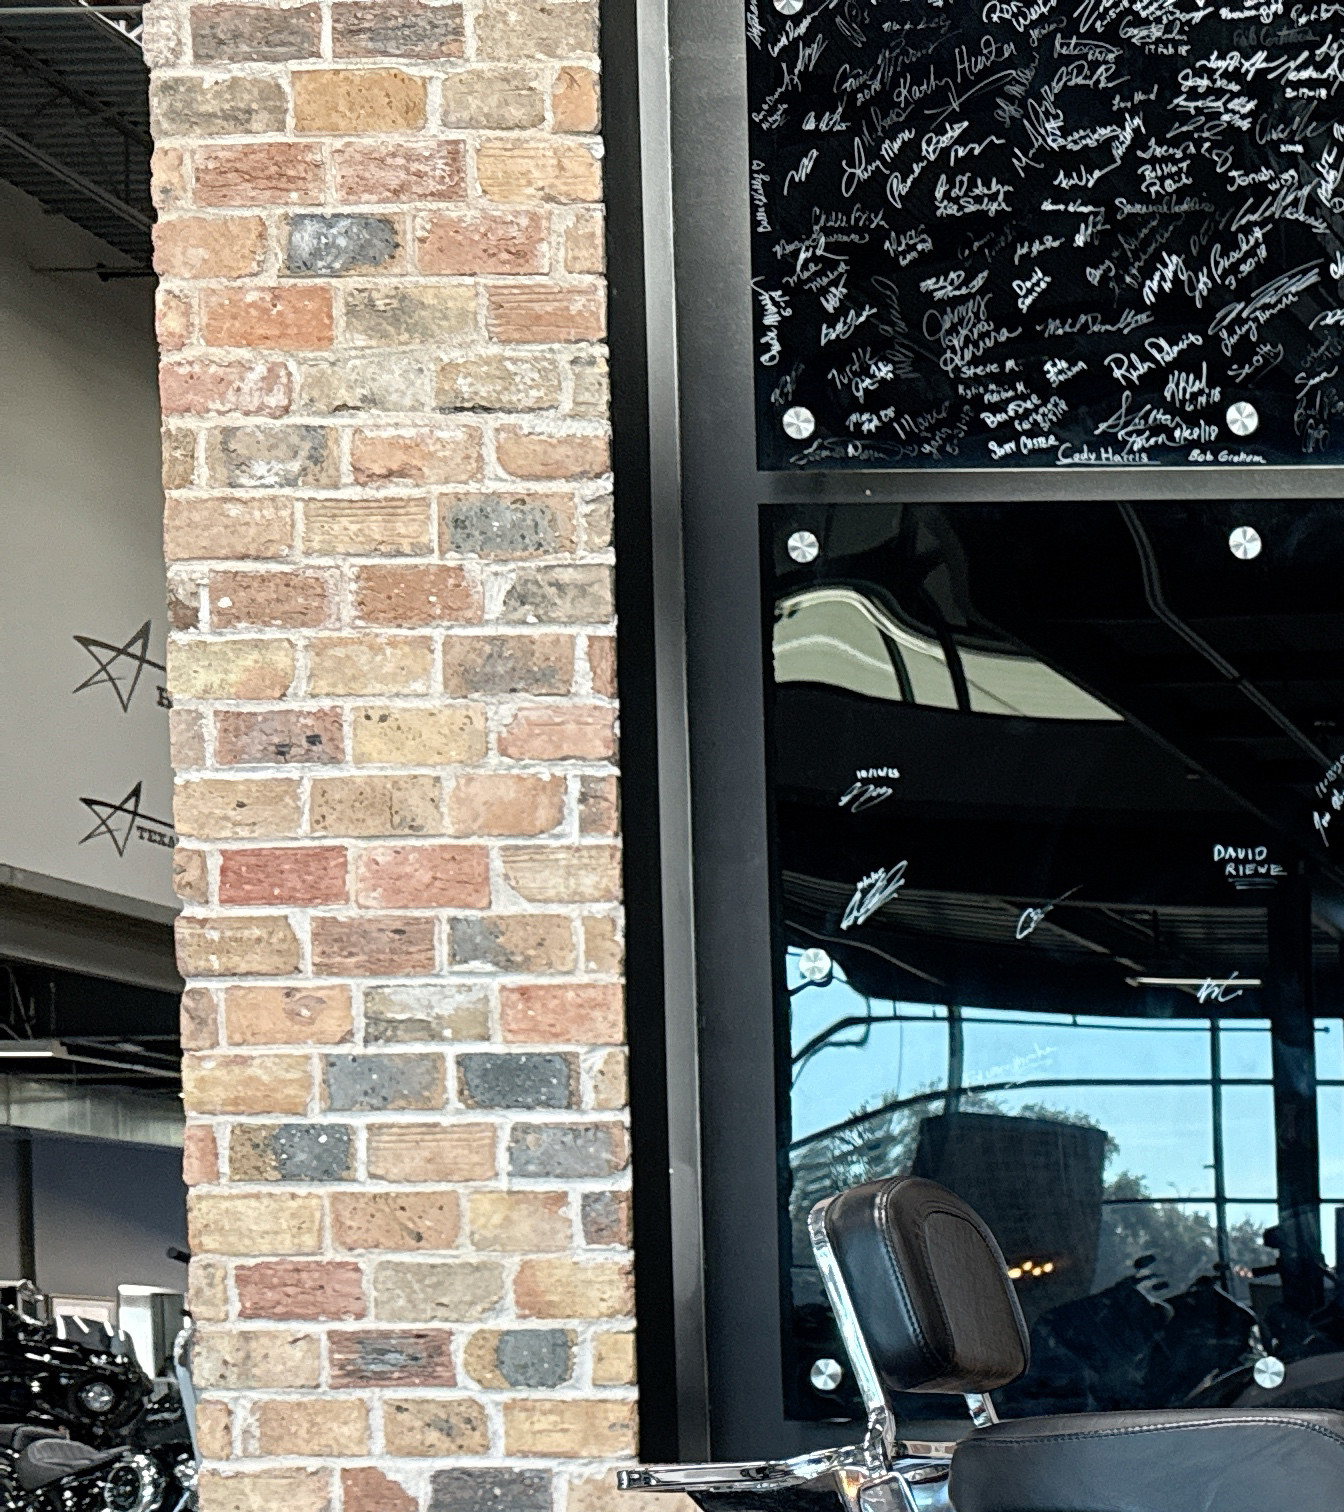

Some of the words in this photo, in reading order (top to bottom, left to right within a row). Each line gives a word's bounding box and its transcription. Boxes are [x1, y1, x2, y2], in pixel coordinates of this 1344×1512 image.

[136, 826, 179, 849] TEXA
[1213, 844, 1267, 862] DAVID
[1225, 863, 1288, 876] RIEWE
